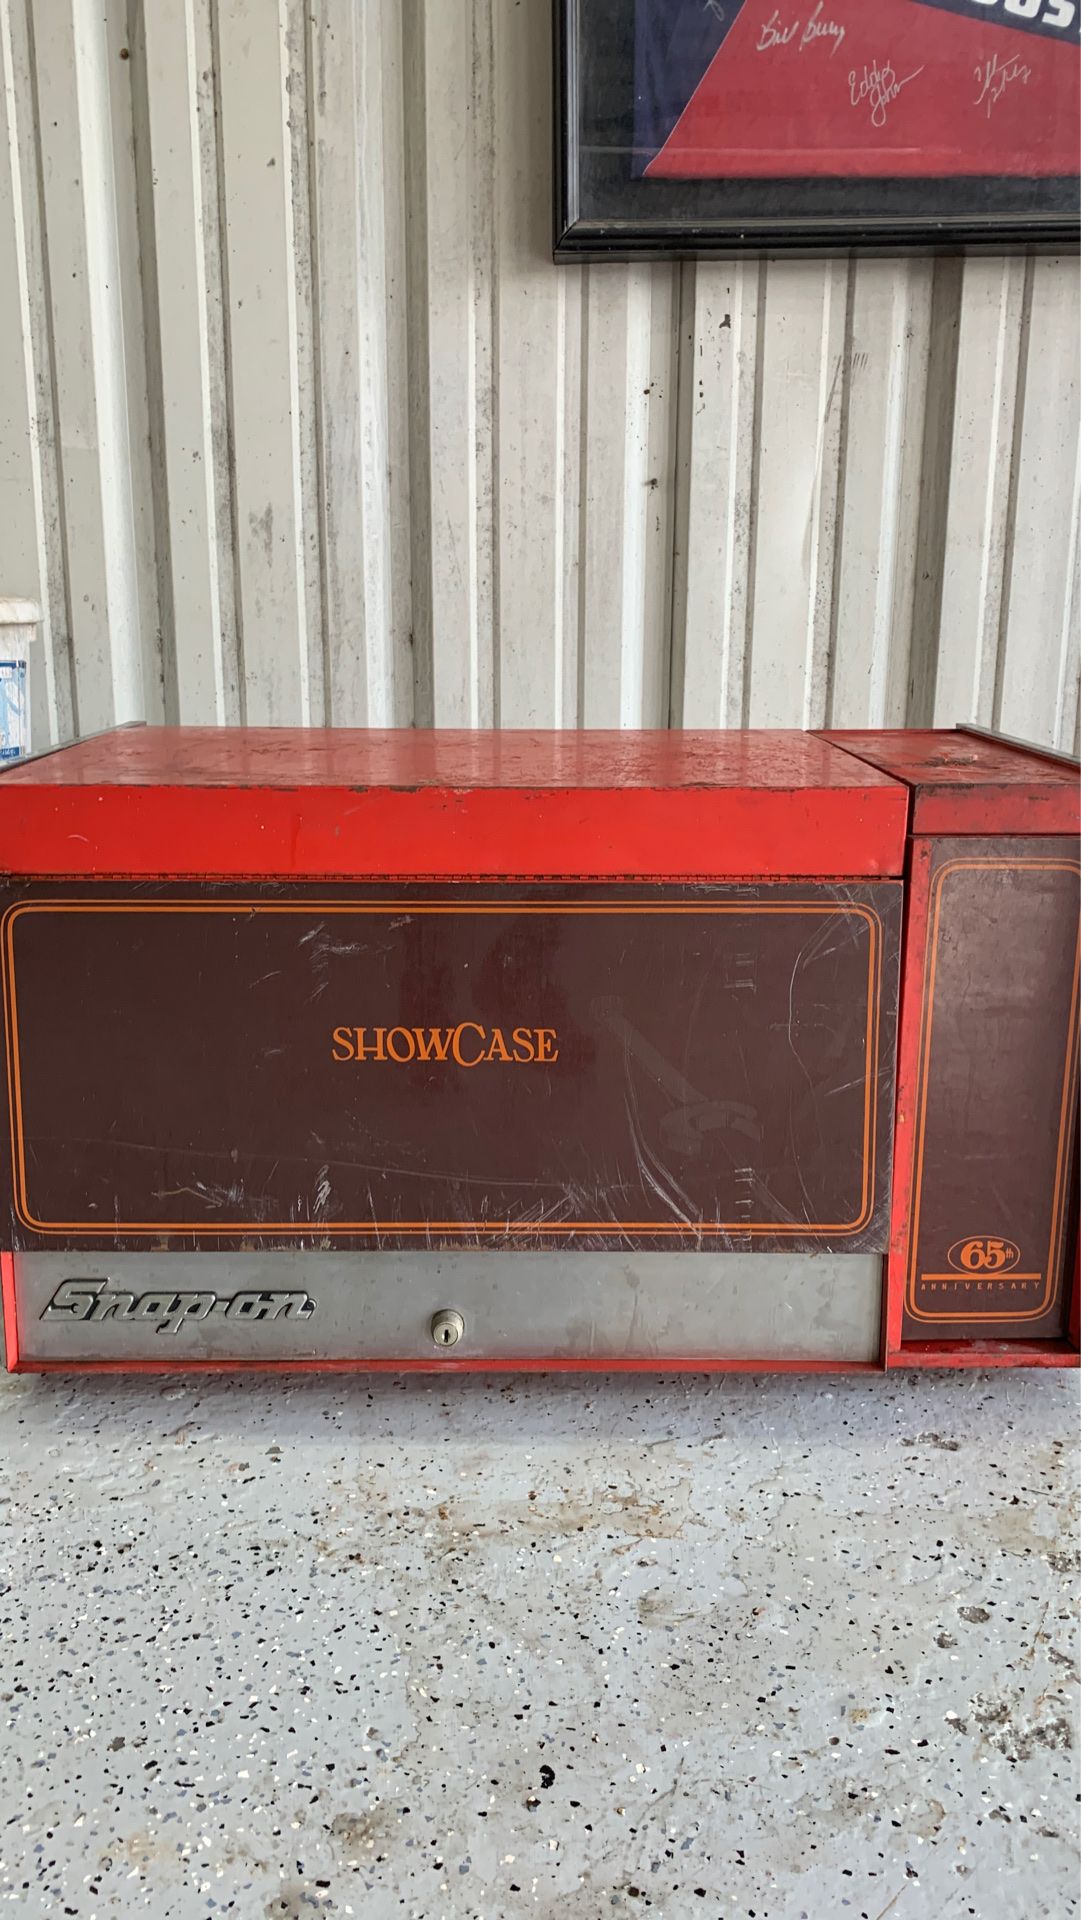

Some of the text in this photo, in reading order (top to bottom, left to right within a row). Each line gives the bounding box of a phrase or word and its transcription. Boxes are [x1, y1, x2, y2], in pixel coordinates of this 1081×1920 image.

[332, 1022, 559, 1067] SHOWCASE
[960, 1240, 1014, 1270] 65th
[920, 1281, 1041, 1292] ANNIVERSARY
[39, 1277, 318, 1334] Snap-on
